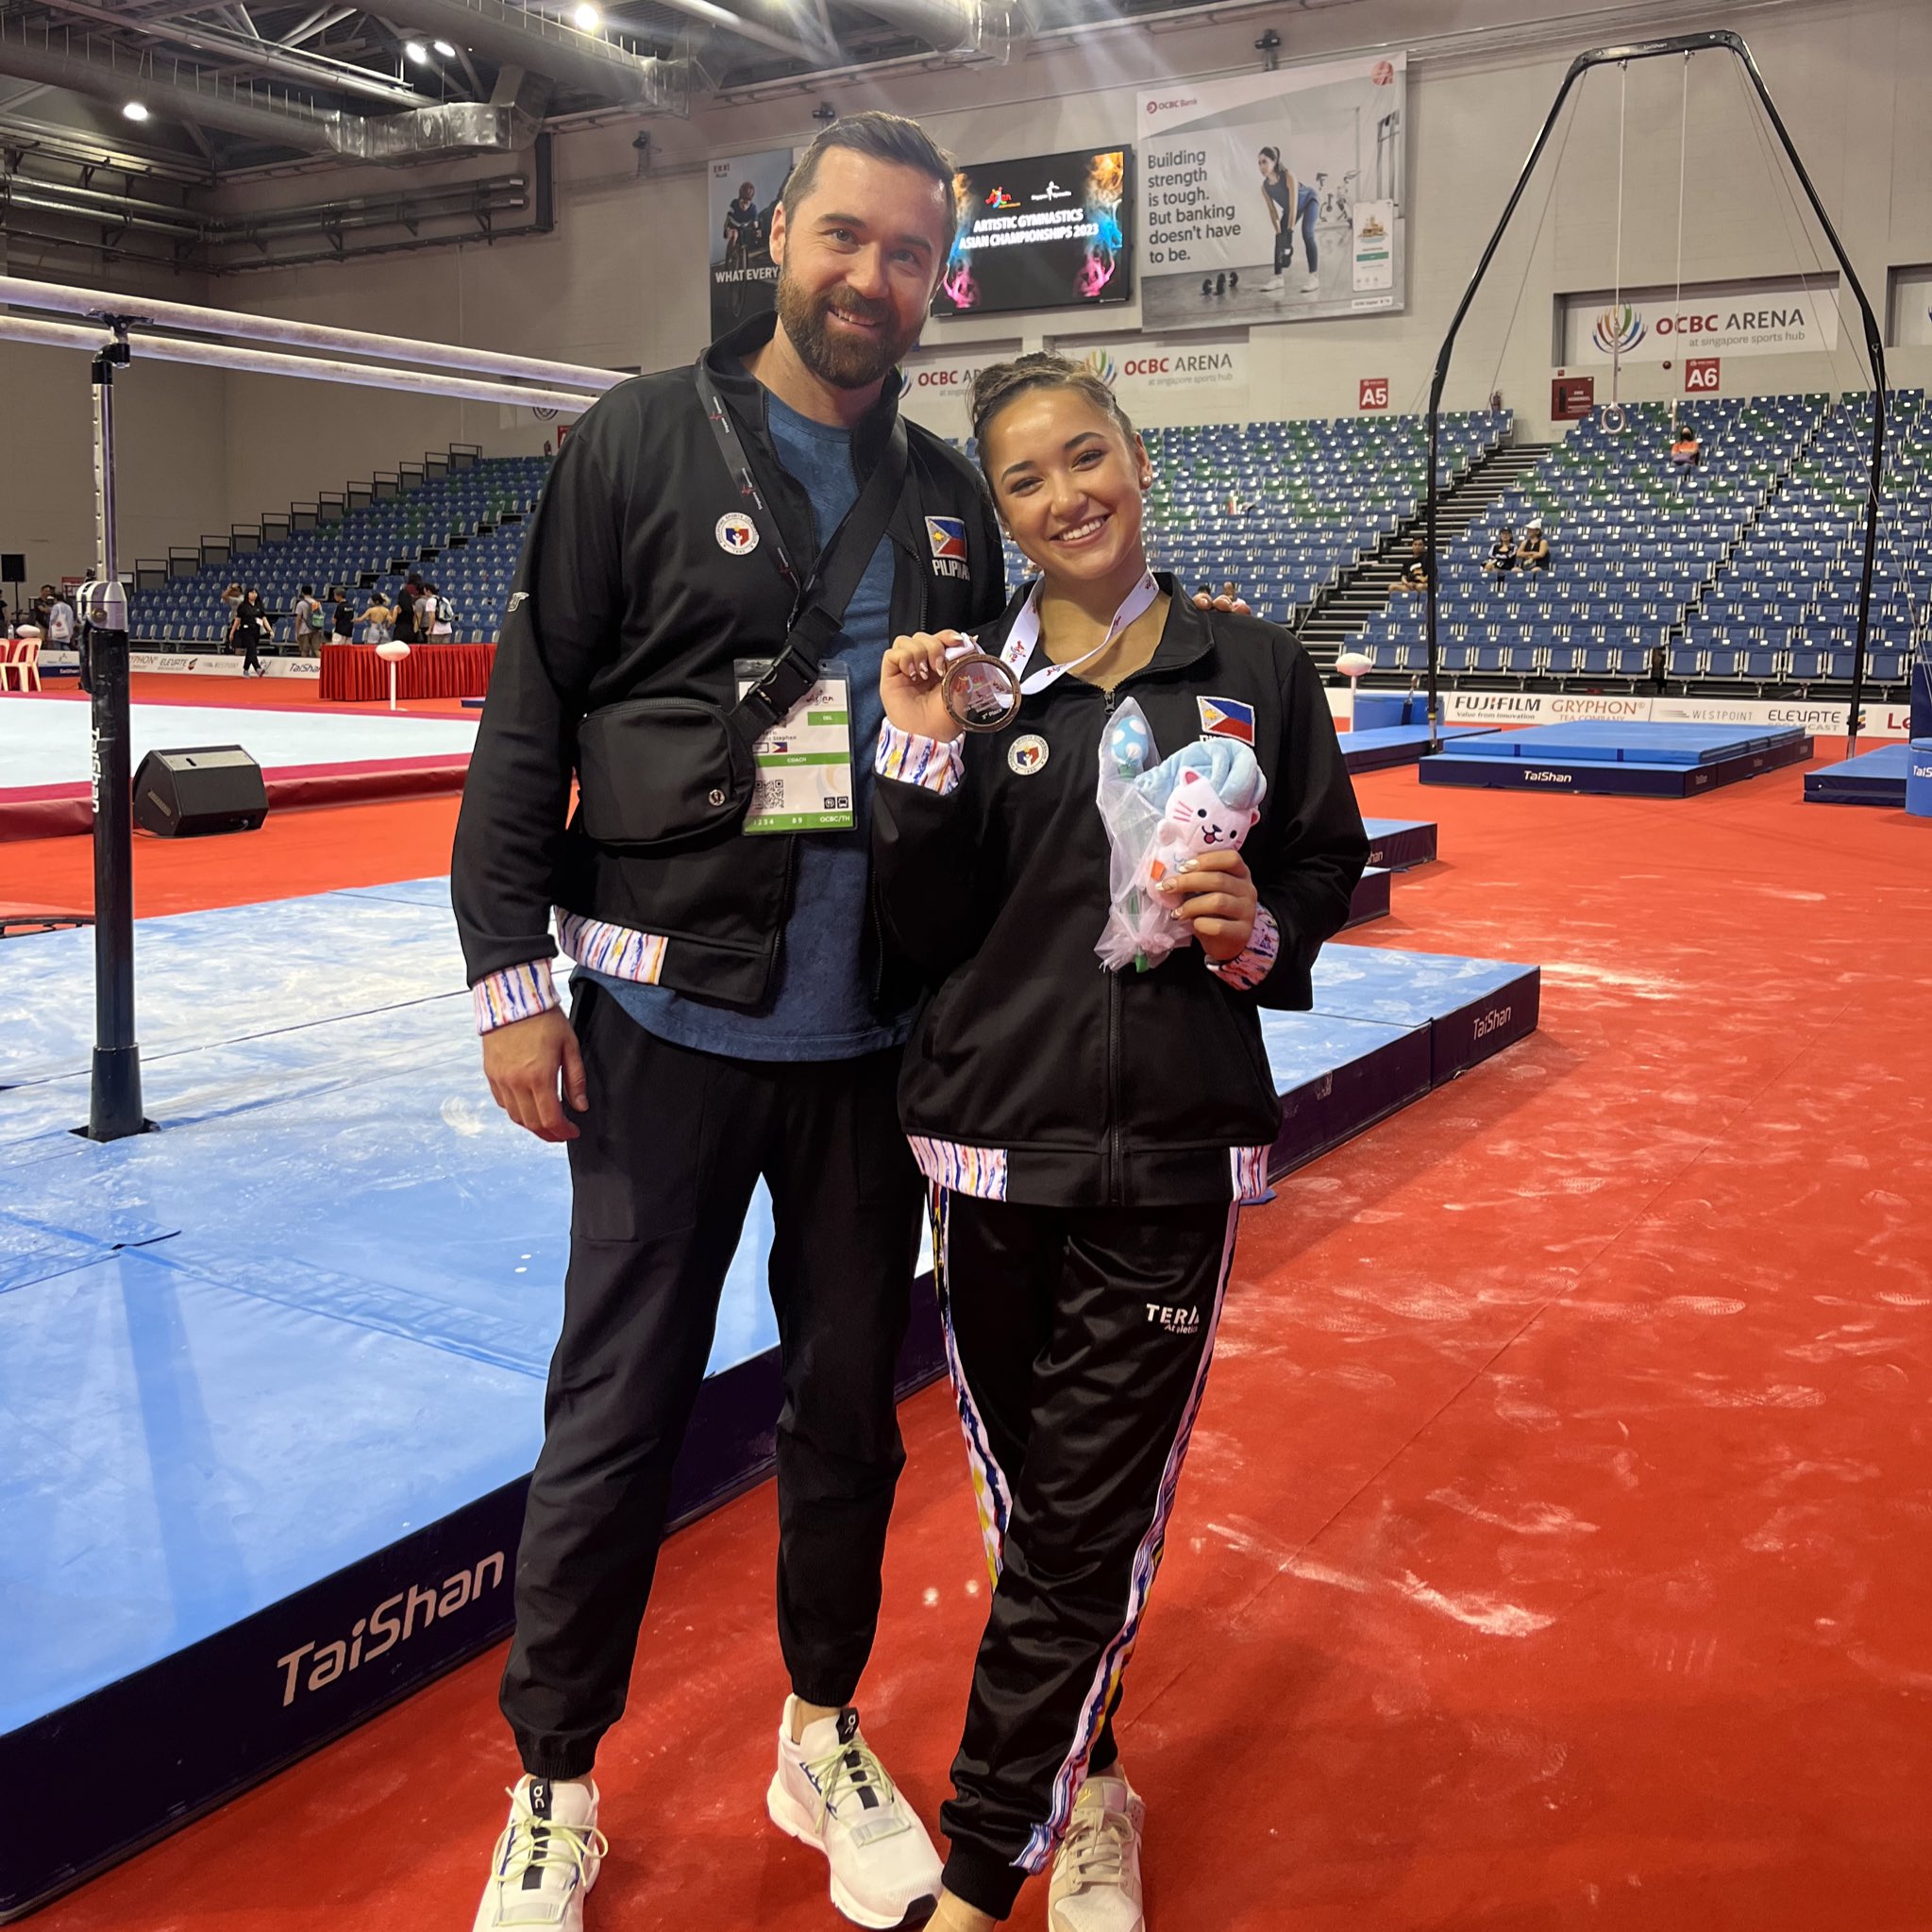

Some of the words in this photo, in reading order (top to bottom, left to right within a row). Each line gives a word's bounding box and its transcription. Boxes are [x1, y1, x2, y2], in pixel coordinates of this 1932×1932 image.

[1159, 100, 1179, 110] OCBC
[1148, 150, 1206, 169] Building
[1148, 167, 1207, 188] strength
[1149, 193, 1159, 207] is
[1163, 187, 1209, 206] tough.
[973, 215, 1017, 233] ARTISTIC
[1017, 209, 1084, 227] GYMNASTICS
[1149, 211, 1172, 227] But
[1176, 204, 1235, 223] banking
[959, 235, 990, 250] ASIAN
[990, 226, 1073, 246] CHAMPIONSHIPS
[1073, 224, 1100, 237] 2023
[1149, 226, 1202, 245] doesn't
[1206, 224, 1241, 239] have
[1150, 251, 1164, 263] to
[1168, 247, 1190, 261] be.
[715, 270, 745, 283] WHAT
[747, 267, 779, 280] EVERY
[1655, 314, 1719, 335] OCBC
[1725, 309, 1805, 330] ARENA
[1689, 339, 1699, 347] at
[1701, 335, 1749, 347] singapore
[1751, 333, 1783, 344] sports
[1785, 330, 1806, 341] hub
[1124, 357, 1169, 376] OCBC
[1174, 353, 1233, 372] ARENA
[917, 370, 958, 387] OCBC
[1687, 367, 1718, 388] A6
[1361, 387, 1386, 406] A5
[932, 559, 970, 581] PILIPINA
[1454, 696, 1541, 713] FUJIFILM
[1692, 709, 1753, 721] WESTPOINT
[1768, 709, 1841, 724] ELEVATE
[1523, 769, 1572, 783] TaiShan
[819, 815, 850, 823] OCBC/TH
[1473, 1006, 1512, 1040] TaiShan
[277, 1551, 505, 1707] TaiShan
